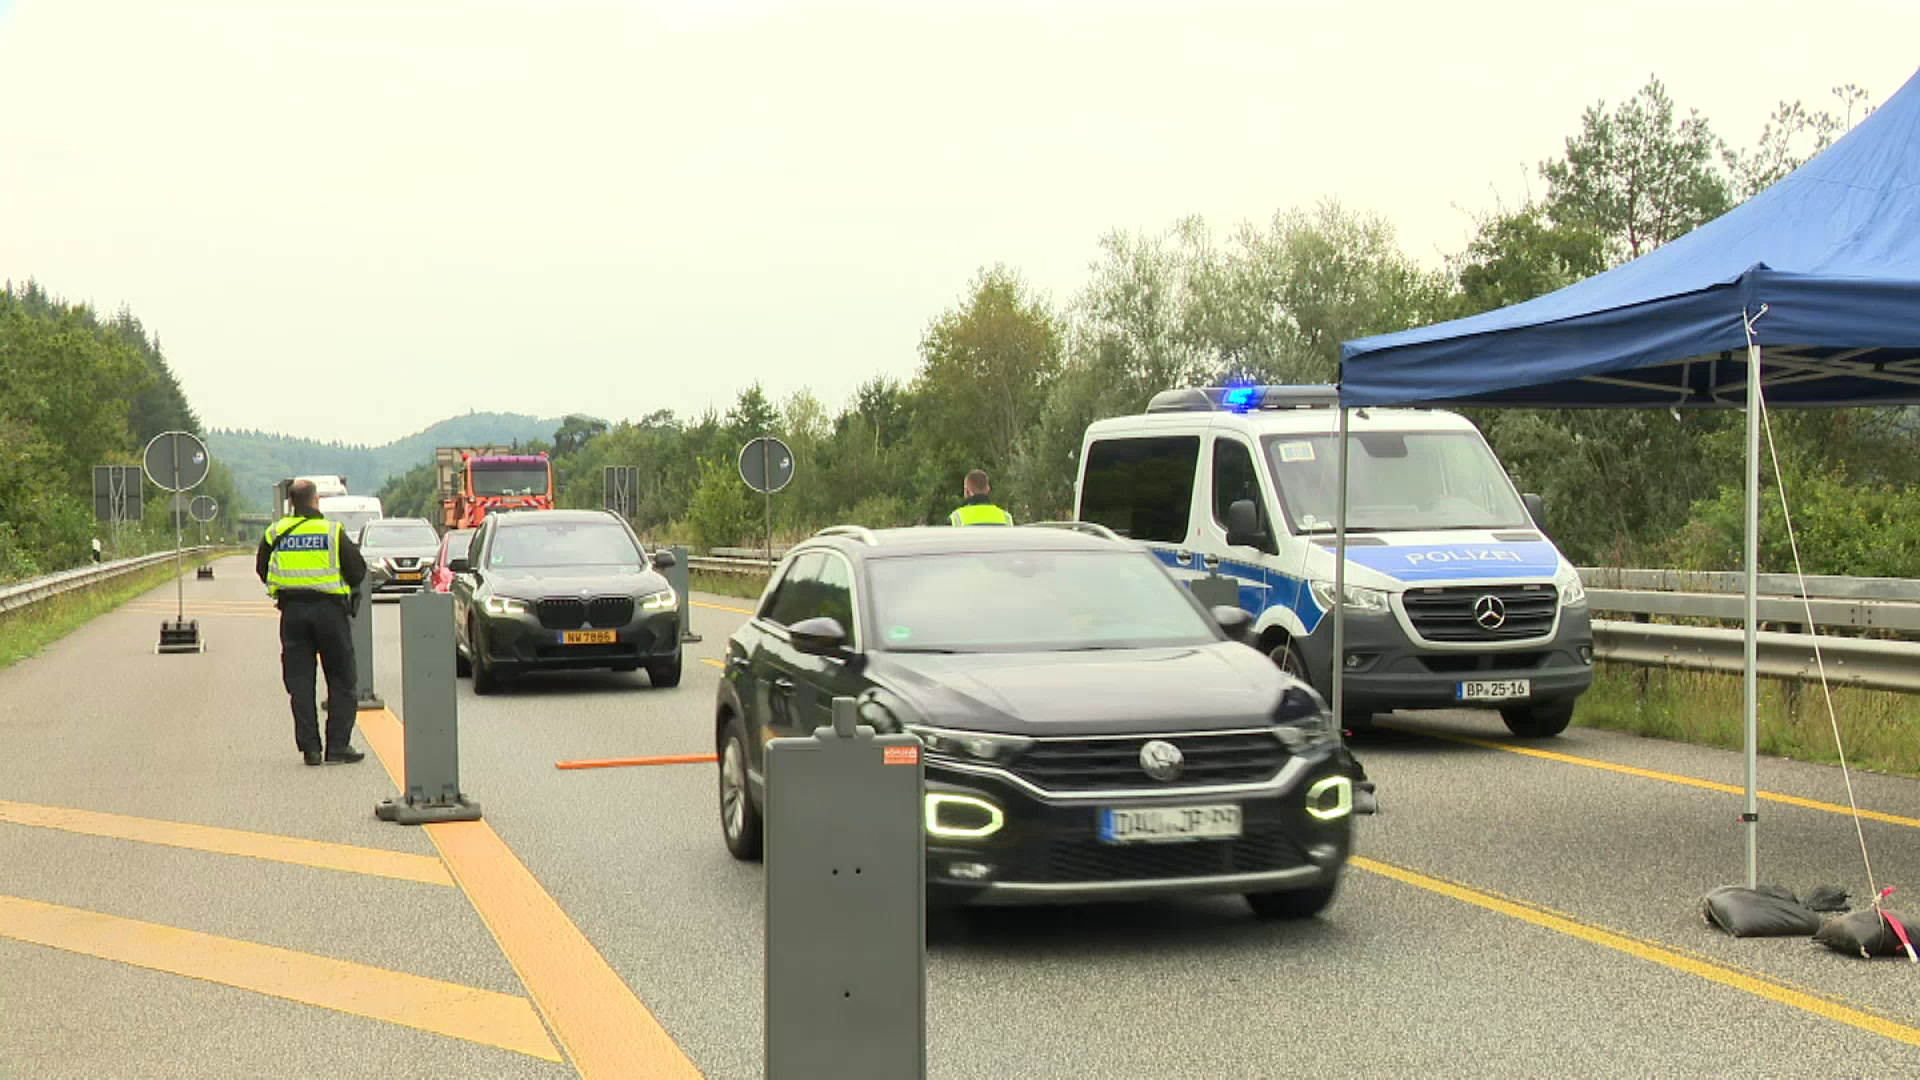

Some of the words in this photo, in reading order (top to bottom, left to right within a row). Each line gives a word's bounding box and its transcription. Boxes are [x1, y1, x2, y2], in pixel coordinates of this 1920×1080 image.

[1404, 550, 1523, 565] POLIZEI
[1467, 683, 1483, 697] BP
[1491, 681, 1525, 697] 25-16
